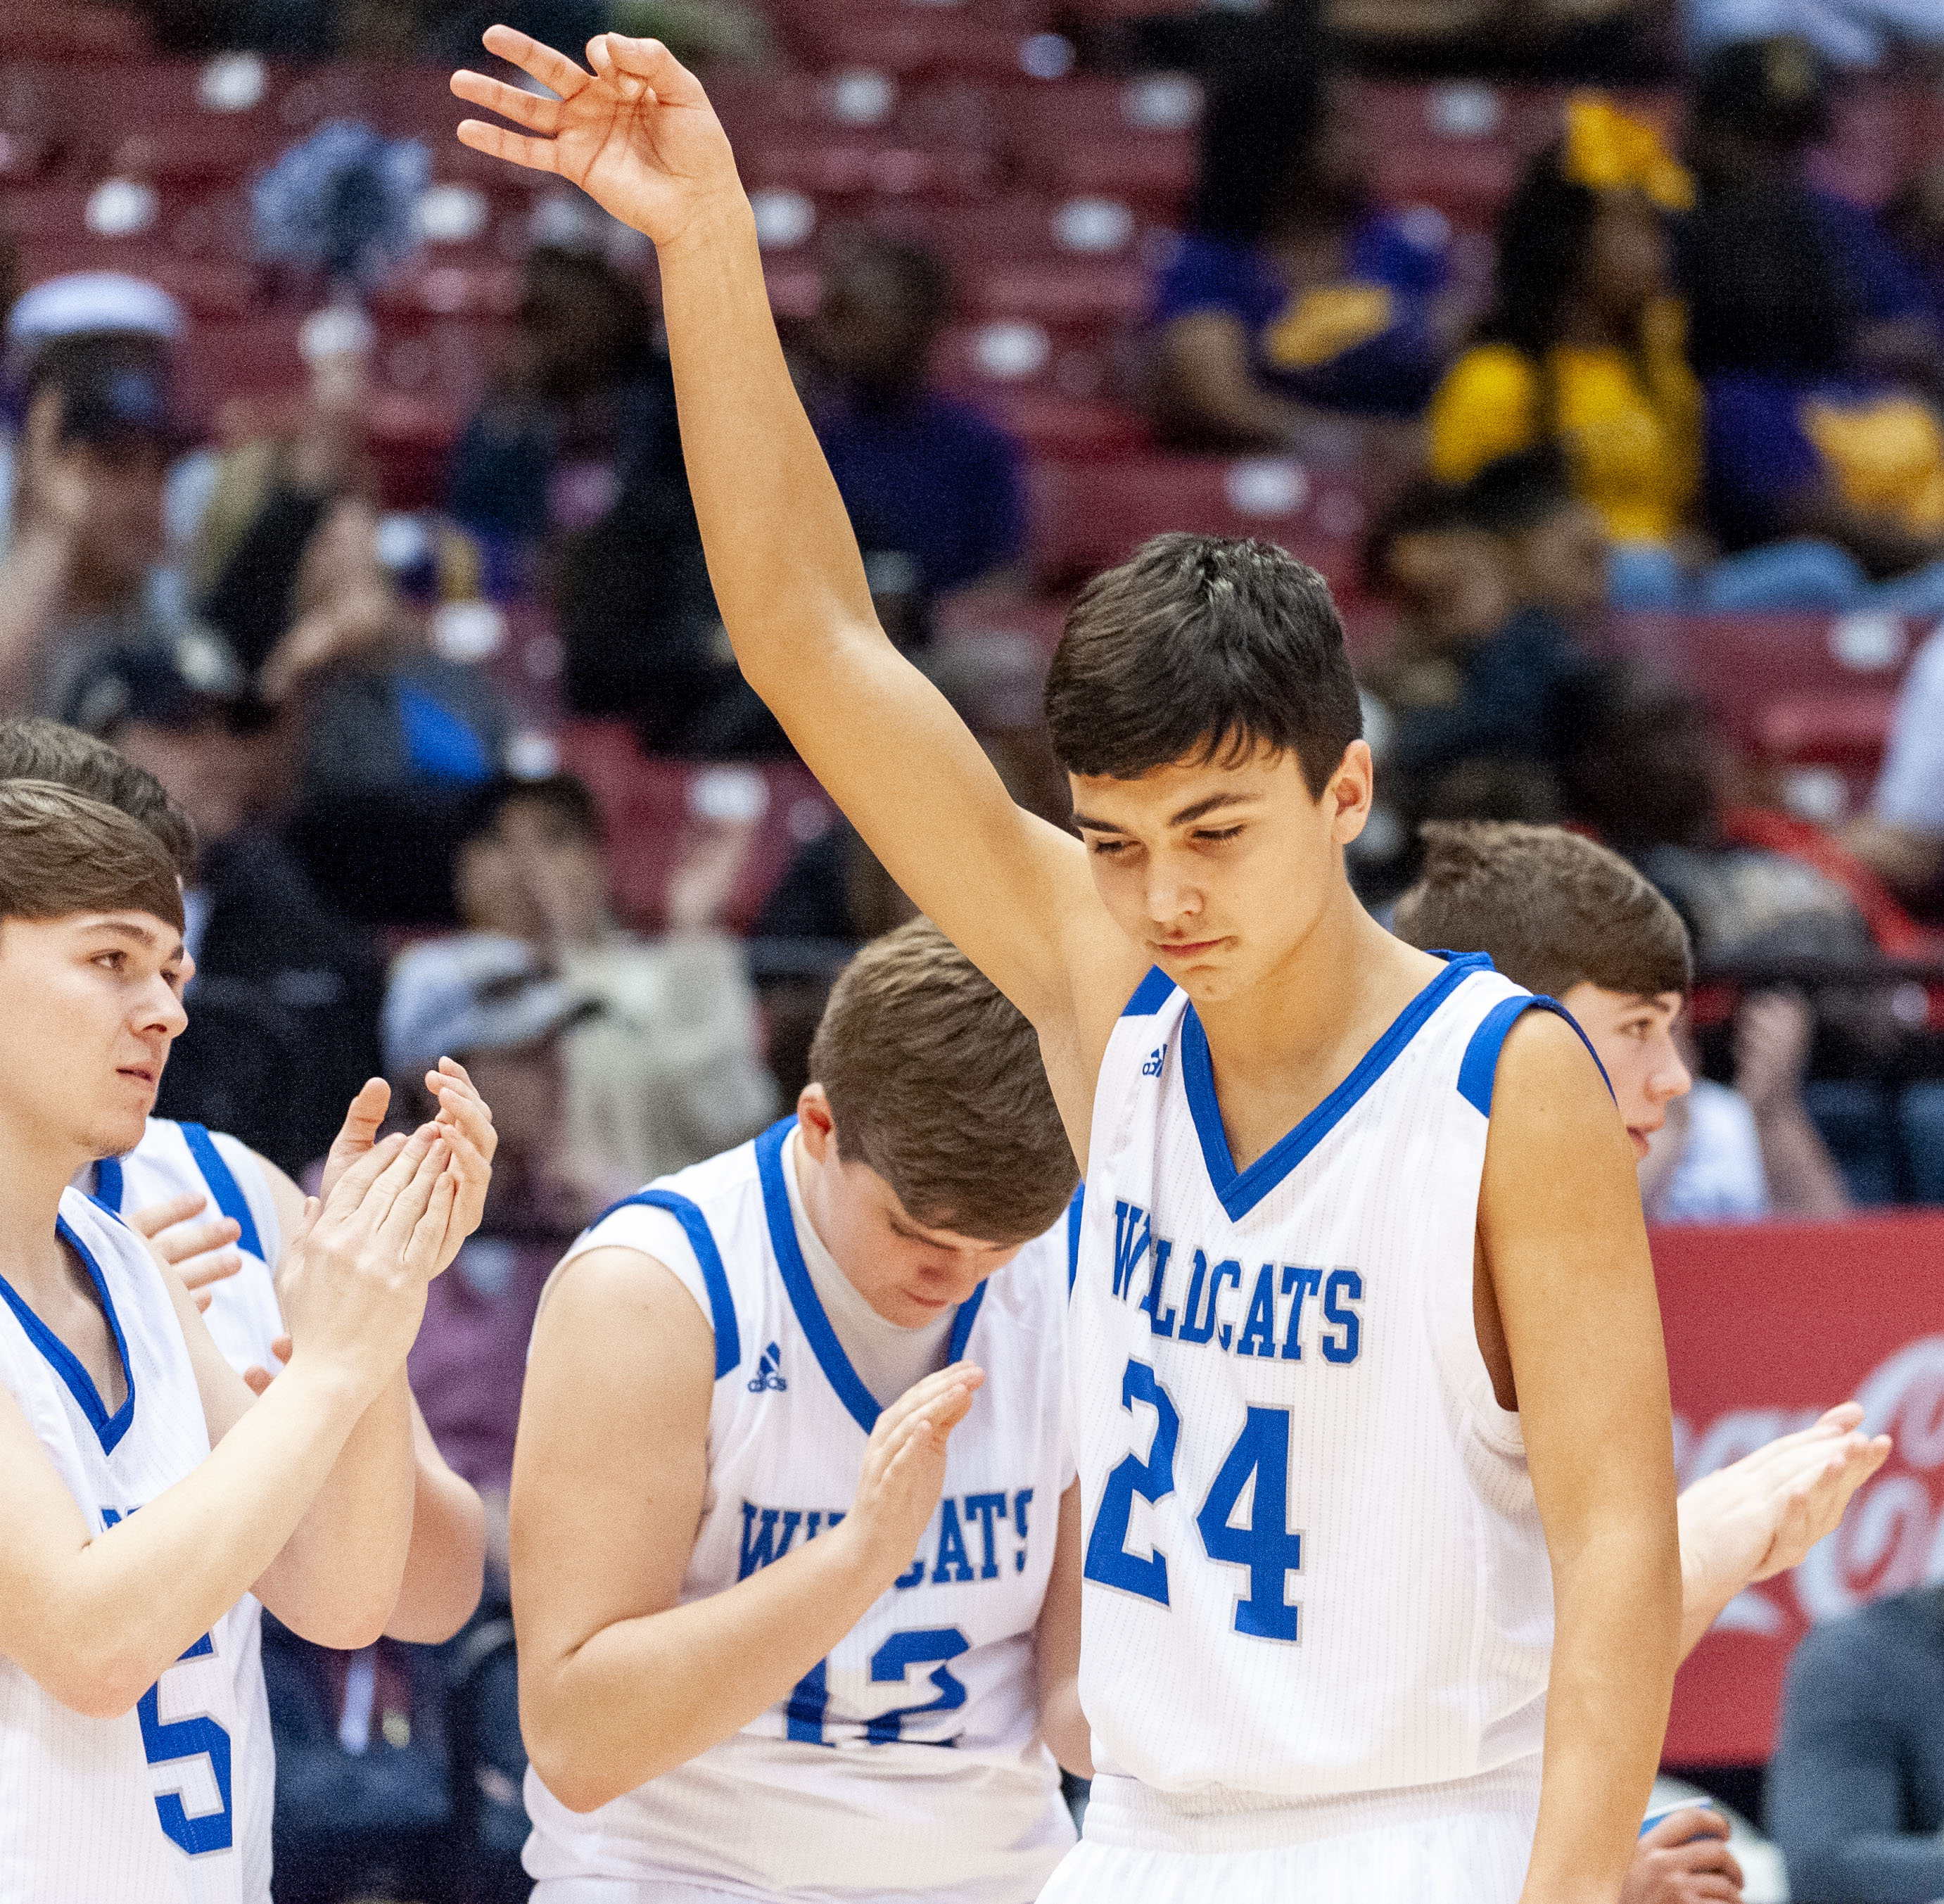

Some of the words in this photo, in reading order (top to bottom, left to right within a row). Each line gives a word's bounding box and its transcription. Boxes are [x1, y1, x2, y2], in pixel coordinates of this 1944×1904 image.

[1112, 1199, 1364, 1365] WLDCATS
[738, 1487, 1034, 1590] WATS
[1084, 1357, 1302, 1642] 24
[136, 1630, 234, 1858] 5
[786, 1627, 971, 1748] 12
